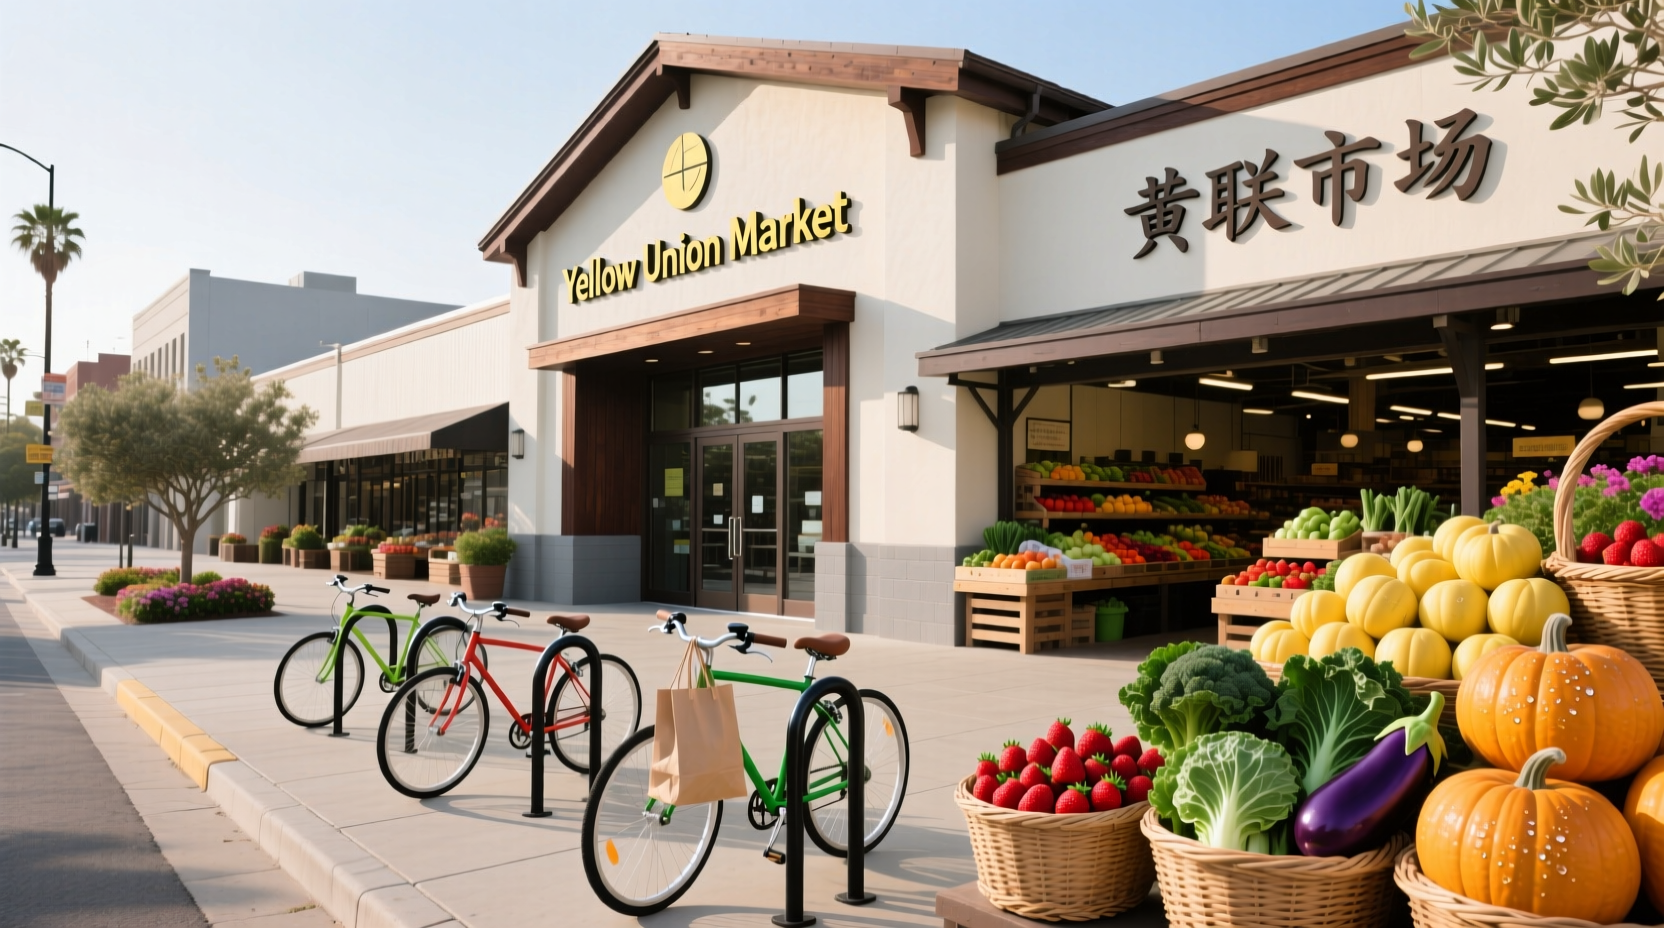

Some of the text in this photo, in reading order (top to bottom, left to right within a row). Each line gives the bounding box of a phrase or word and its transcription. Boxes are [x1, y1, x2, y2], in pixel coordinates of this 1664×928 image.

[562, 191, 852, 304] Yellow Union Market
[1124, 107, 1493, 259] 黄联市场
